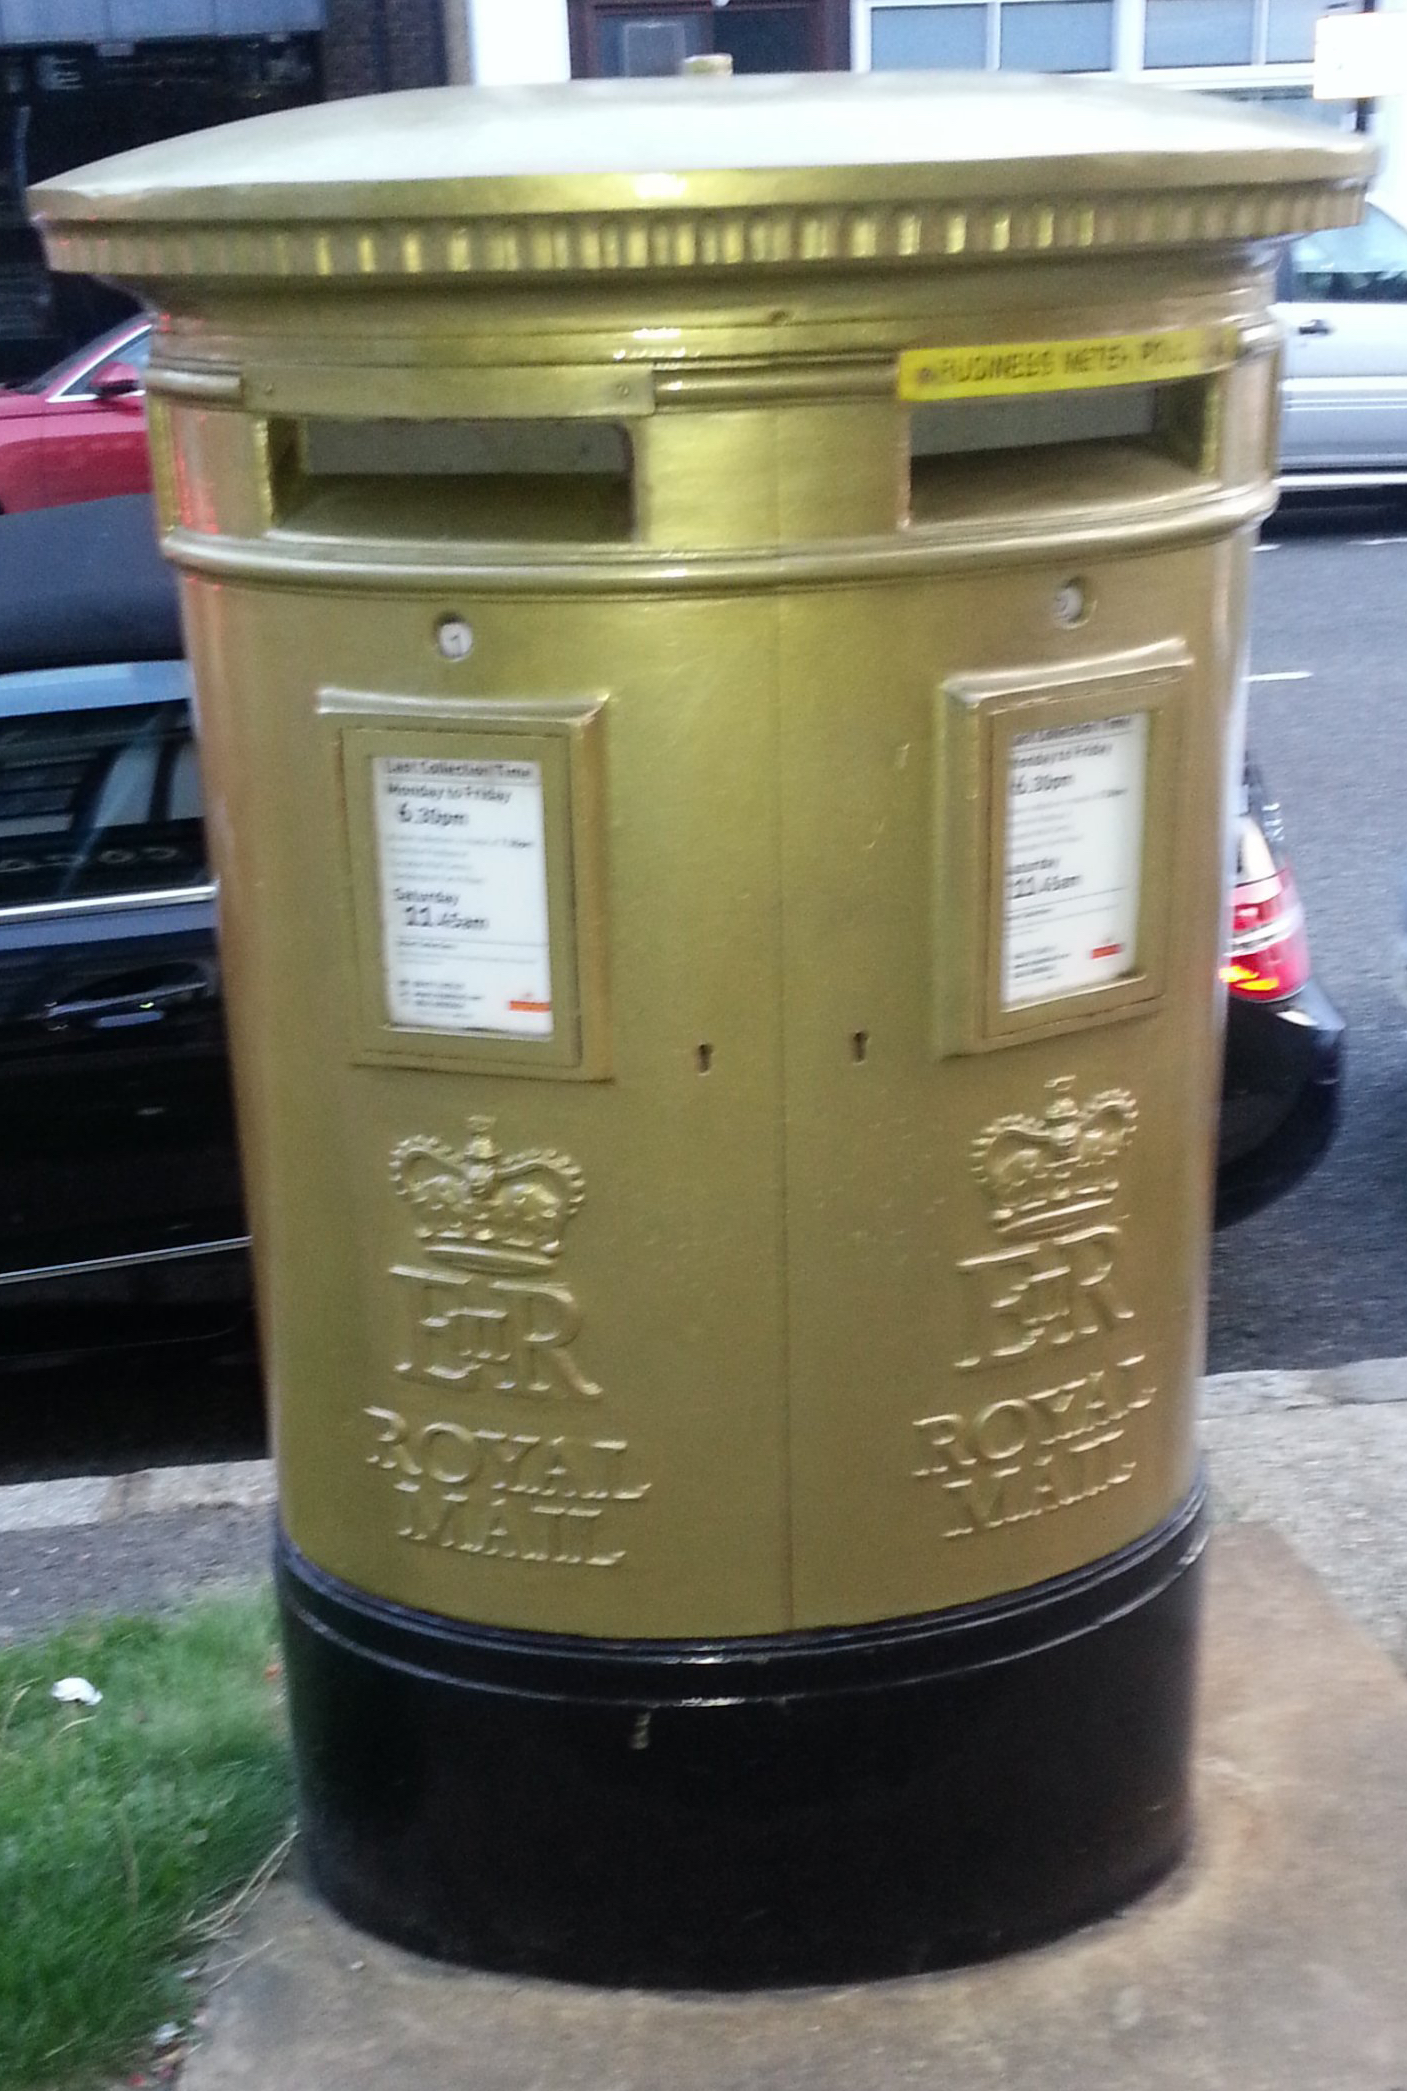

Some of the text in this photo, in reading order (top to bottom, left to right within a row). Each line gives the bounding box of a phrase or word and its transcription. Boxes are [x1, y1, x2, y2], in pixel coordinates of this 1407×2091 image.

[396, 802, 469, 826] 6.30pm
[363, 1405, 653, 1500] ROYAL
[911, 1353, 1159, 1477] ROYAL
[393, 1482, 628, 1567] MAIL
[942, 1429, 1138, 1538] MAIL
